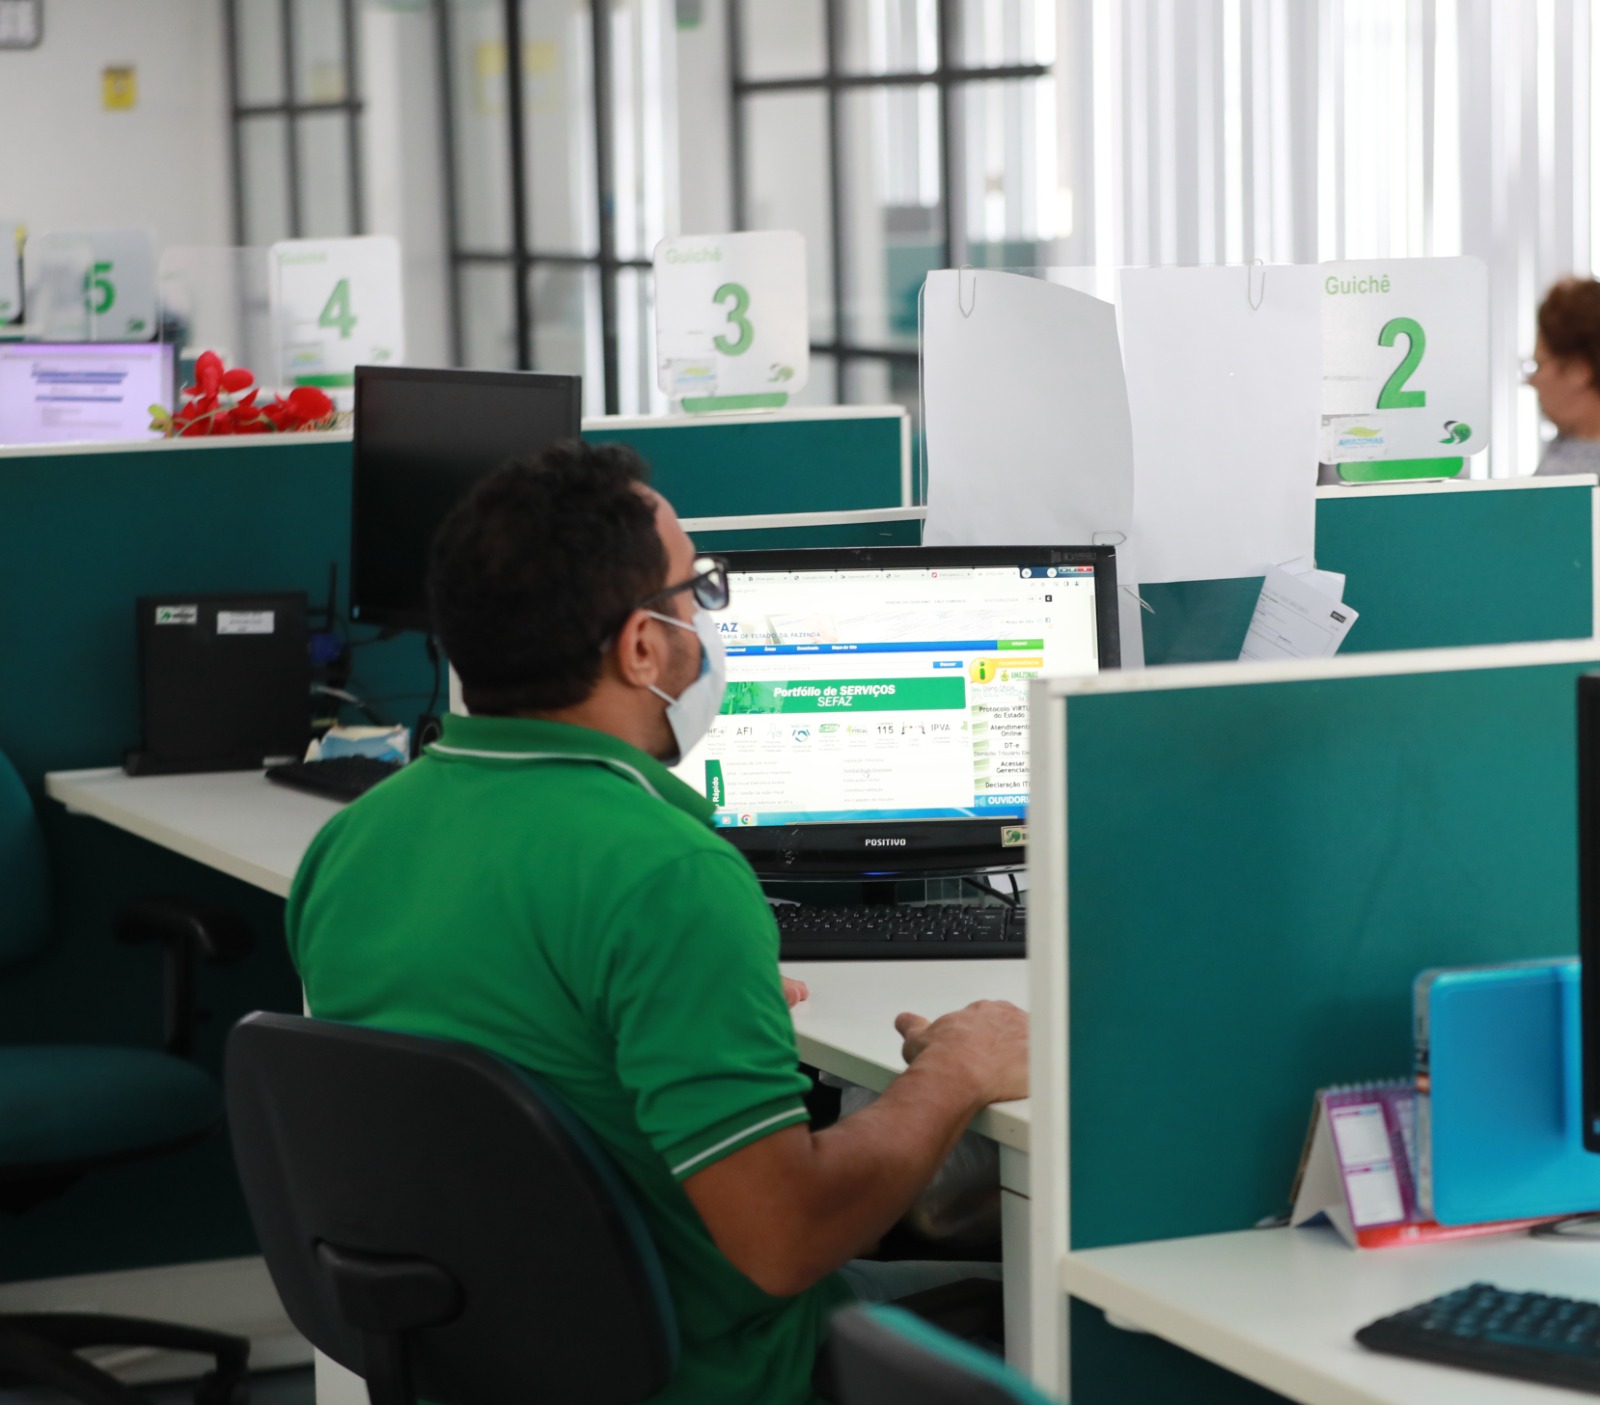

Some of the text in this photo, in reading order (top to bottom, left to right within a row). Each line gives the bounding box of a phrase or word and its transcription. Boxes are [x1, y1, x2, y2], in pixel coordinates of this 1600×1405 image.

[83, 261, 116, 315] 5
[1325, 274, 1391, 295] Guichê
[318, 278, 358, 340] 4
[712, 282, 754, 357] 3
[1376, 316, 1427, 409] 2
[1011, 671, 1038, 679] AMAZONAS
[773, 684, 895, 697] Portfólio de SERVIÇOS
[817, 696, 853, 707] SEFAZ
[736, 726, 753, 735] AFI
[877, 725, 894, 735] 115
[930, 723, 951, 732] IPVA
[712, 776, 720, 803] Rápido
[985, 781, 1021, 789] Declaração
[865, 838, 906, 846] POSITIVO
